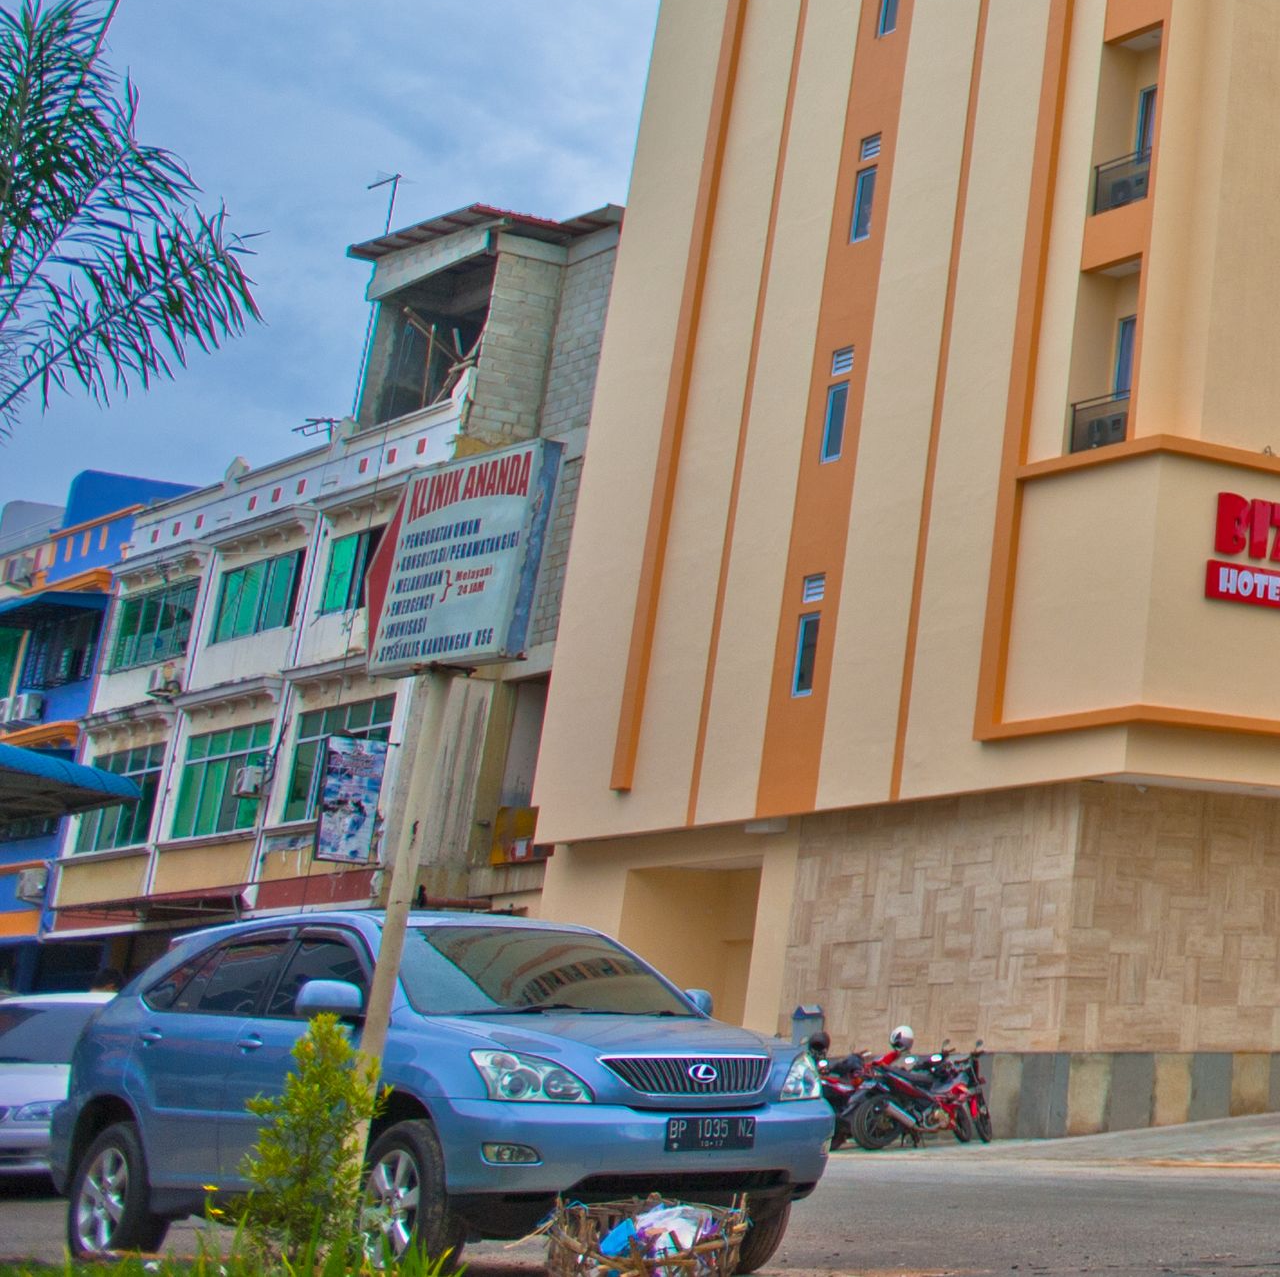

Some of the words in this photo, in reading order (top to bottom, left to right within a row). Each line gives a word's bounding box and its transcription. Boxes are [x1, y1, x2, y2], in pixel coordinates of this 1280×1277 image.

[408, 468, 466, 524] KLINIK
[461, 450, 533, 501] ANANDA
[404, 524, 452, 549] PENGOBATAN
[453, 518, 482, 538] UMUM
[501, 530, 520, 549] GIGI
[395, 569, 444, 595] MELAHIRKAN
[455, 565, 494, 582] Melayani
[457, 584, 468, 596] 24
[468, 580, 486, 594] JAM
[390, 593, 436, 617] EMERGENCY
[474, 627, 494, 646] USG
[669, 1120, 688, 1139] BP
[698, 1119, 729, 1139] 1035
[737, 1118, 754, 1138] NZ
